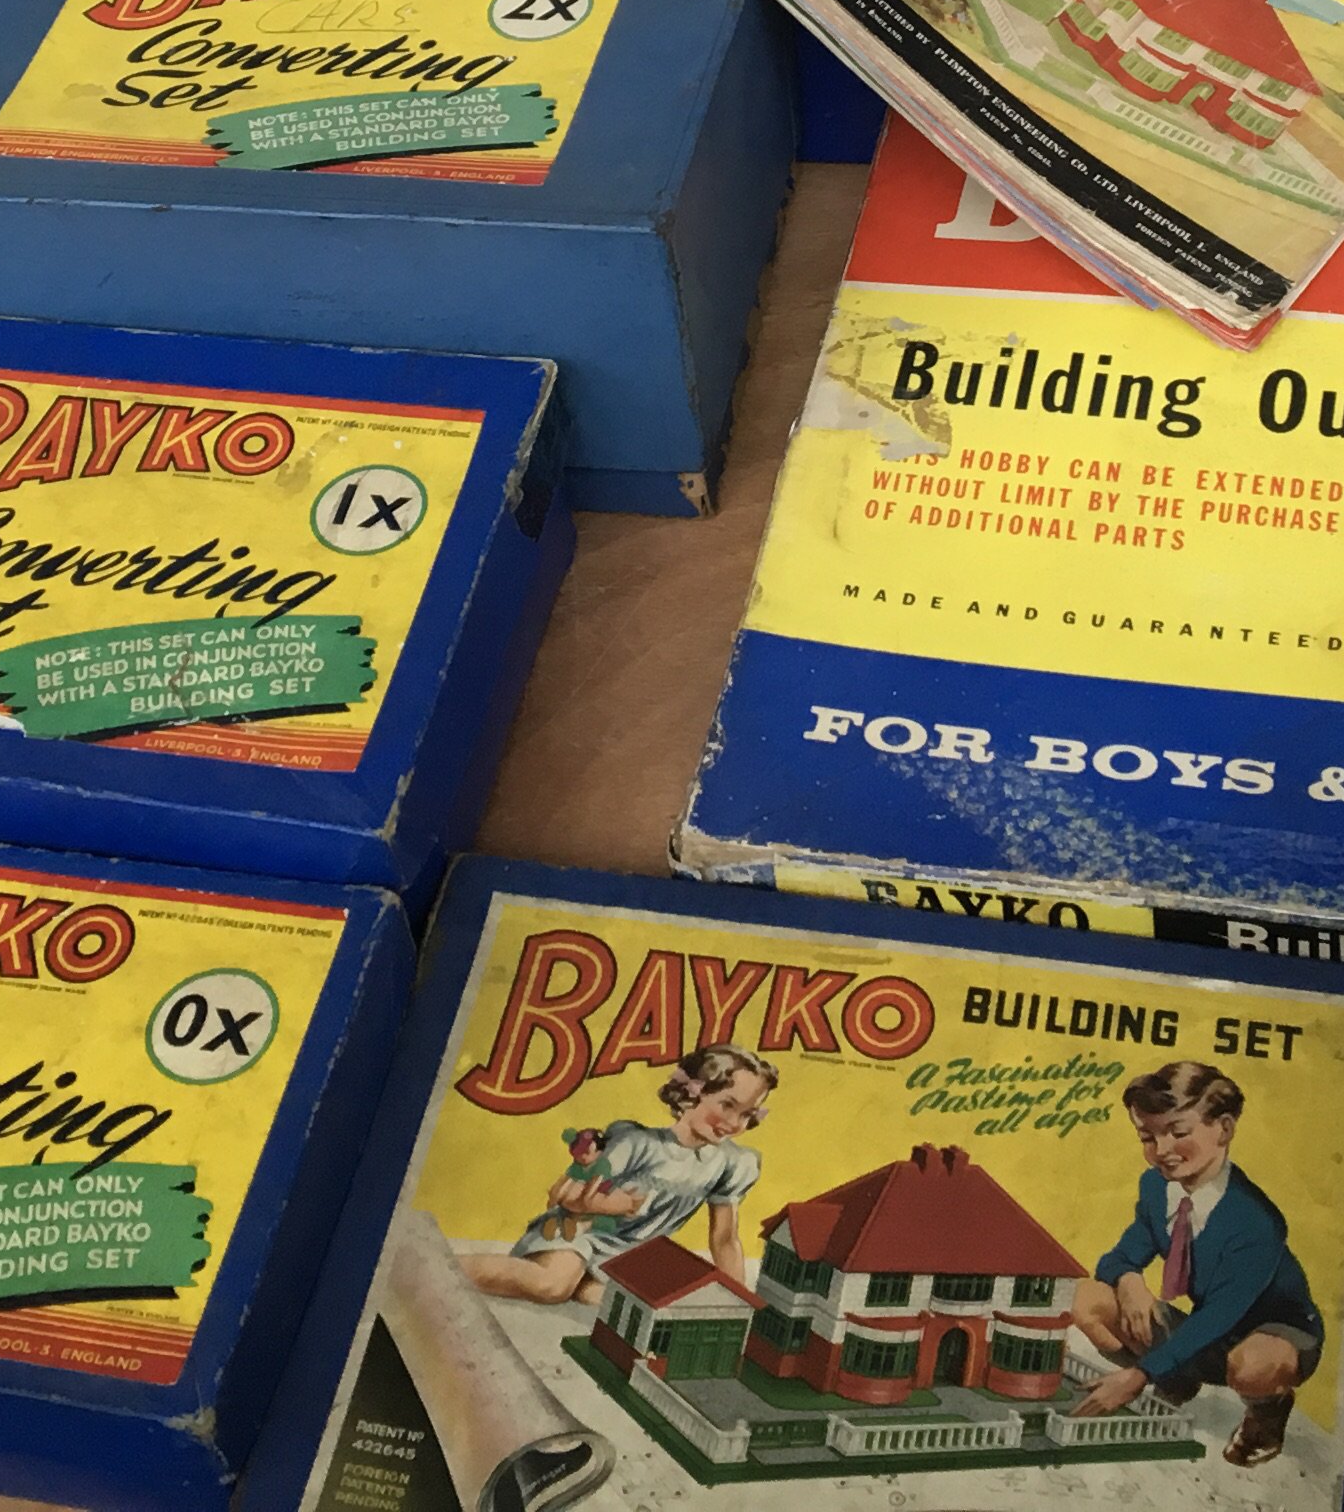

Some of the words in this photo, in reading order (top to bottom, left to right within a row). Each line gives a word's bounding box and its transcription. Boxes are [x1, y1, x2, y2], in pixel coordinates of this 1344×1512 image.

[128, 19, 517, 97] Converting
[102, 70, 259, 111] Set
[916, 31, 932, 45] BY
[934, 47, 991, 96] PLIMPTON
[991, 96, 1068, 159] ENGINEERING
[1070, 157, 1090, 176] CO.
[1093, 174, 1120, 196] LTD.
[1123, 194, 1193, 243] LIVERPOOL
[1214, 253, 1264, 287] ENGLAND
[892, 341, 1206, 439] Building
[872, 470, 986, 501] WITHOUT
[1001, 482, 1072, 509] LIMIT
[1088, 491, 1120, 513] BY
[1137, 495, 1184, 520] THE
[1200, 501, 1341, 534] PURCHASE
[960, 449, 1050, 476] HOBBY
[1068, 459, 1122, 483] CAN
[1142, 465, 1175, 488] BE
[1196, 470, 1344, 503] EXTENDED
[864, 498, 898, 520] OF
[909, 505, 1078, 542] ADDITIONAL
[1093, 523, 1186, 552] PARTS
[843, 584, 944, 610] MADE
[967, 600, 1039, 621] AND
[1062, 610, 1344, 652] GUARANTEED
[803, 705, 995, 765] FOR
[1025, 734, 1276, 795] BOYS
[455, 929, 935, 1116] BAYKO
[964, 986, 1179, 1048] BUILDING
[1215, 1018, 1304, 1061] SET
[945, 1052, 1125, 1087] Fascinating
[1055, 1079, 1106, 1111] for
[974, 1107, 1032, 1135] all
[1034, 1103, 1114, 1138] ages
[86, 1248, 141, 1269] SET
[352, 1440, 416, 1460] 422645
[356, 1420, 405, 1439] PATENT
[344, 1463, 410, 1483] FOREIGN
